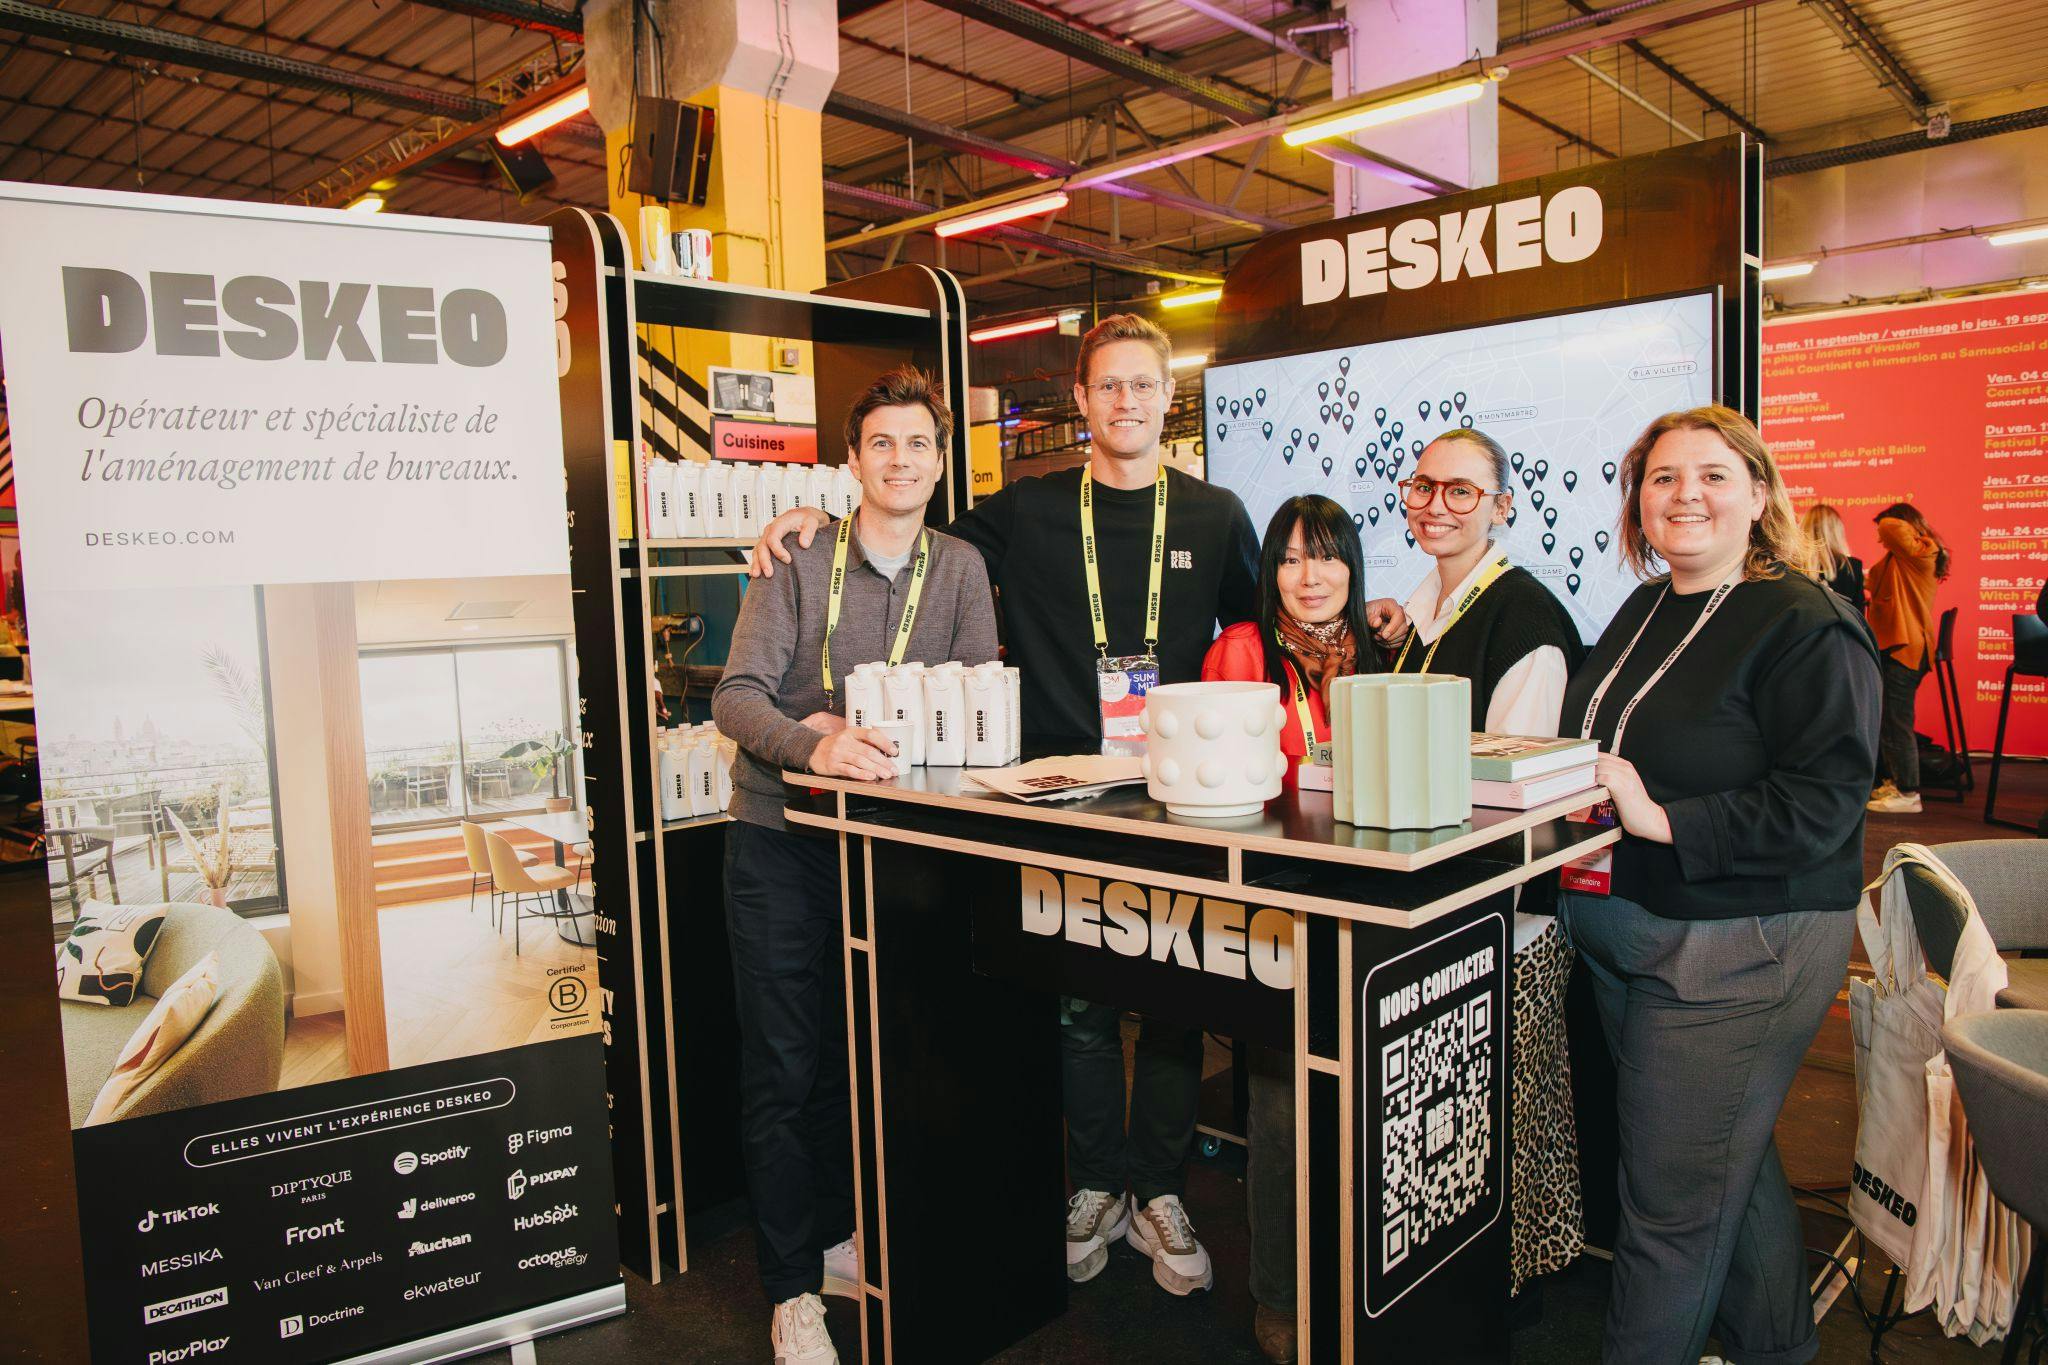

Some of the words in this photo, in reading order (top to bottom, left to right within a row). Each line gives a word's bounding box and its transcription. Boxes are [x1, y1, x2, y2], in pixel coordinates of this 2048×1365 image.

[1301, 186, 1603, 306] DESKEO
[62, 265, 508, 367] DESKEO
[1776, 341, 1800, 351] mer.
[1804, 338, 1813, 348] 11
[1817, 332, 1879, 347] septembre
[1891, 322, 1958, 338] vernissage
[1961, 320, 1973, 330] le
[1976, 317, 2001, 331] jeu.
[2005, 315, 2019, 325] 19
[2023, 313, 2048, 324] sep
[1773, 354, 1806, 365] photo
[1816, 347, 1861, 359] Instants
[1865, 341, 1920, 353] d'évasion
[1855, 360, 1869, 369] en
[1872, 353, 1937, 367] immersion
[1940, 350, 1955, 359] au
[1960, 341, 2035, 358] Samusocial
[1654, 365, 1692, 375] VILLETTE
[1986, 373, 2017, 384] Ven.
[2020, 370, 2039, 381] 04
[1763, 391, 1818, 404] eptembre
[1986, 385, 2042, 398] Concert
[1786, 402, 1829, 415] Festival
[1986, 399, 2025, 408] concert
[77, 396, 257, 437] Opérateur
[265, 407, 295, 431] et
[302, 401, 458, 440] spécialiste
[465, 404, 498, 434] de
[1484, 410, 1533, 420] MONTMARTRE
[1811, 413, 1844, 422] concert
[1985, 424, 2004, 435] Du
[2007, 424, 2036, 434] ven.
[723, 433, 785, 451] Cuisines
[1820, 449, 1836, 459] vin
[1839, 448, 1854, 458] du
[1858, 446, 1885, 456] Petit
[1889, 444, 1926, 455] Ballon
[1985, 437, 2036, 449] Festival
[1868, 458, 1878, 467] dj
[1879, 457, 1893, 465] set
[1984, 450, 2010, 459] table
[2012, 448, 2043, 457] ronde
[81, 448, 333, 489] l'aménagement
[343, 451, 378, 482] de
[386, 452, 519, 482] bureaux.
[972, 469, 993, 483] om
[1983, 475, 2012, 486] Jeu.
[2016, 474, 2030, 484] 17
[1821, 496, 1844, 506] être
[1847, 493, 1904, 508] populaire
[1982, 502, 2004, 512] quiz
[86, 531, 235, 547] DESKEO.COM
[839, 520, 849, 543] DESKEO
[1981, 526, 2010, 536] Jeu.
[2013, 526, 2030, 536] 24
[1085, 536, 1095, 564] DESKEO
[1981, 540, 2037, 551] Bouillon
[916, 552, 926, 578] DESKEO
[1170, 550, 1192, 561] DES
[1170, 559, 1193, 569] KEO
[1981, 552, 2020, 560] concert
[833, 567, 842, 595] DESKEO
[1980, 577, 2013, 587] Sam.
[2016, 577, 2034, 587] 26
[1458, 586, 1481, 613] DESKEO
[1705, 583, 1731, 614] DESKEO
[1980, 591, 2020, 600] Witch
[1092, 593, 1101, 622] DESKEO
[1150, 592, 1158, 621] DESKEO
[1979, 603, 2017, 611] marché
[2024, 603, 2036, 611] at
[902, 605, 914, 633] DESKEO
[1978, 627, 2009, 637] Dim.
[1978, 641, 2007, 650] Beat
[1660, 642, 1686, 671] DESKEO
[1133, 673, 1155, 683] SUM
[1138, 681, 1155, 691] MIT
[2011, 682, 2045, 692] aussi
[1584, 697, 1599, 730] DESKEO
[1618, 698, 1638, 730] DESKEO
[1598, 807, 1613, 818] MIT
[1569, 875, 1601, 887] Partenaire
[1020, 865, 1296, 990] DESKEO
[546, 964, 586, 977] Certified
[559, 984, 577, 1006] B
[1379, 982, 1419, 1028] NOUS
[1422, 945, 1495, 1005] CONTACTER
[551, 1019, 589, 1030] Corporation
[211, 1141, 260, 1155] ELLES
[266, 1124, 323, 1145] VIVENT
[329, 1100, 432, 1132] L'EXPÉRIENCE
[436, 1090, 492, 1112] DESKEO
[1426, 1096, 1454, 1134] DES
[527, 1125, 572, 1144] Figma
[1425, 1126, 1454, 1160] KEO
[421, 1147, 470, 1166] Spotify
[271, 1170, 352, 1199] DIPTYQUE
[530, 1165, 578, 1186] PIXPAY
[301, 1192, 327, 1204] PARIS
[420, 1191, 476, 1212] deliveroo
[1852, 1160, 1917, 1228] DESKEO
[163, 1202, 220, 1224] TikTok
[513, 1204, 578, 1231] HubSpot
[285, 1217, 345, 1246] Front
[141, 1248, 223, 1278] MESSIKA
[518, 1246, 577, 1270] octopus
[554, 1251, 588, 1269] energy
[254, 1278, 281, 1293] Van
[285, 1265, 323, 1285] Cleef
[326, 1260, 337, 1274] &
[339, 1251, 383, 1275] Arpels
[403, 1270, 482, 1301] ekwateur
[149, 1291, 223, 1319] DECATHLON
[309, 1304, 365, 1327] Doctrine
[149, 1335, 230, 1365] PlayPlay
